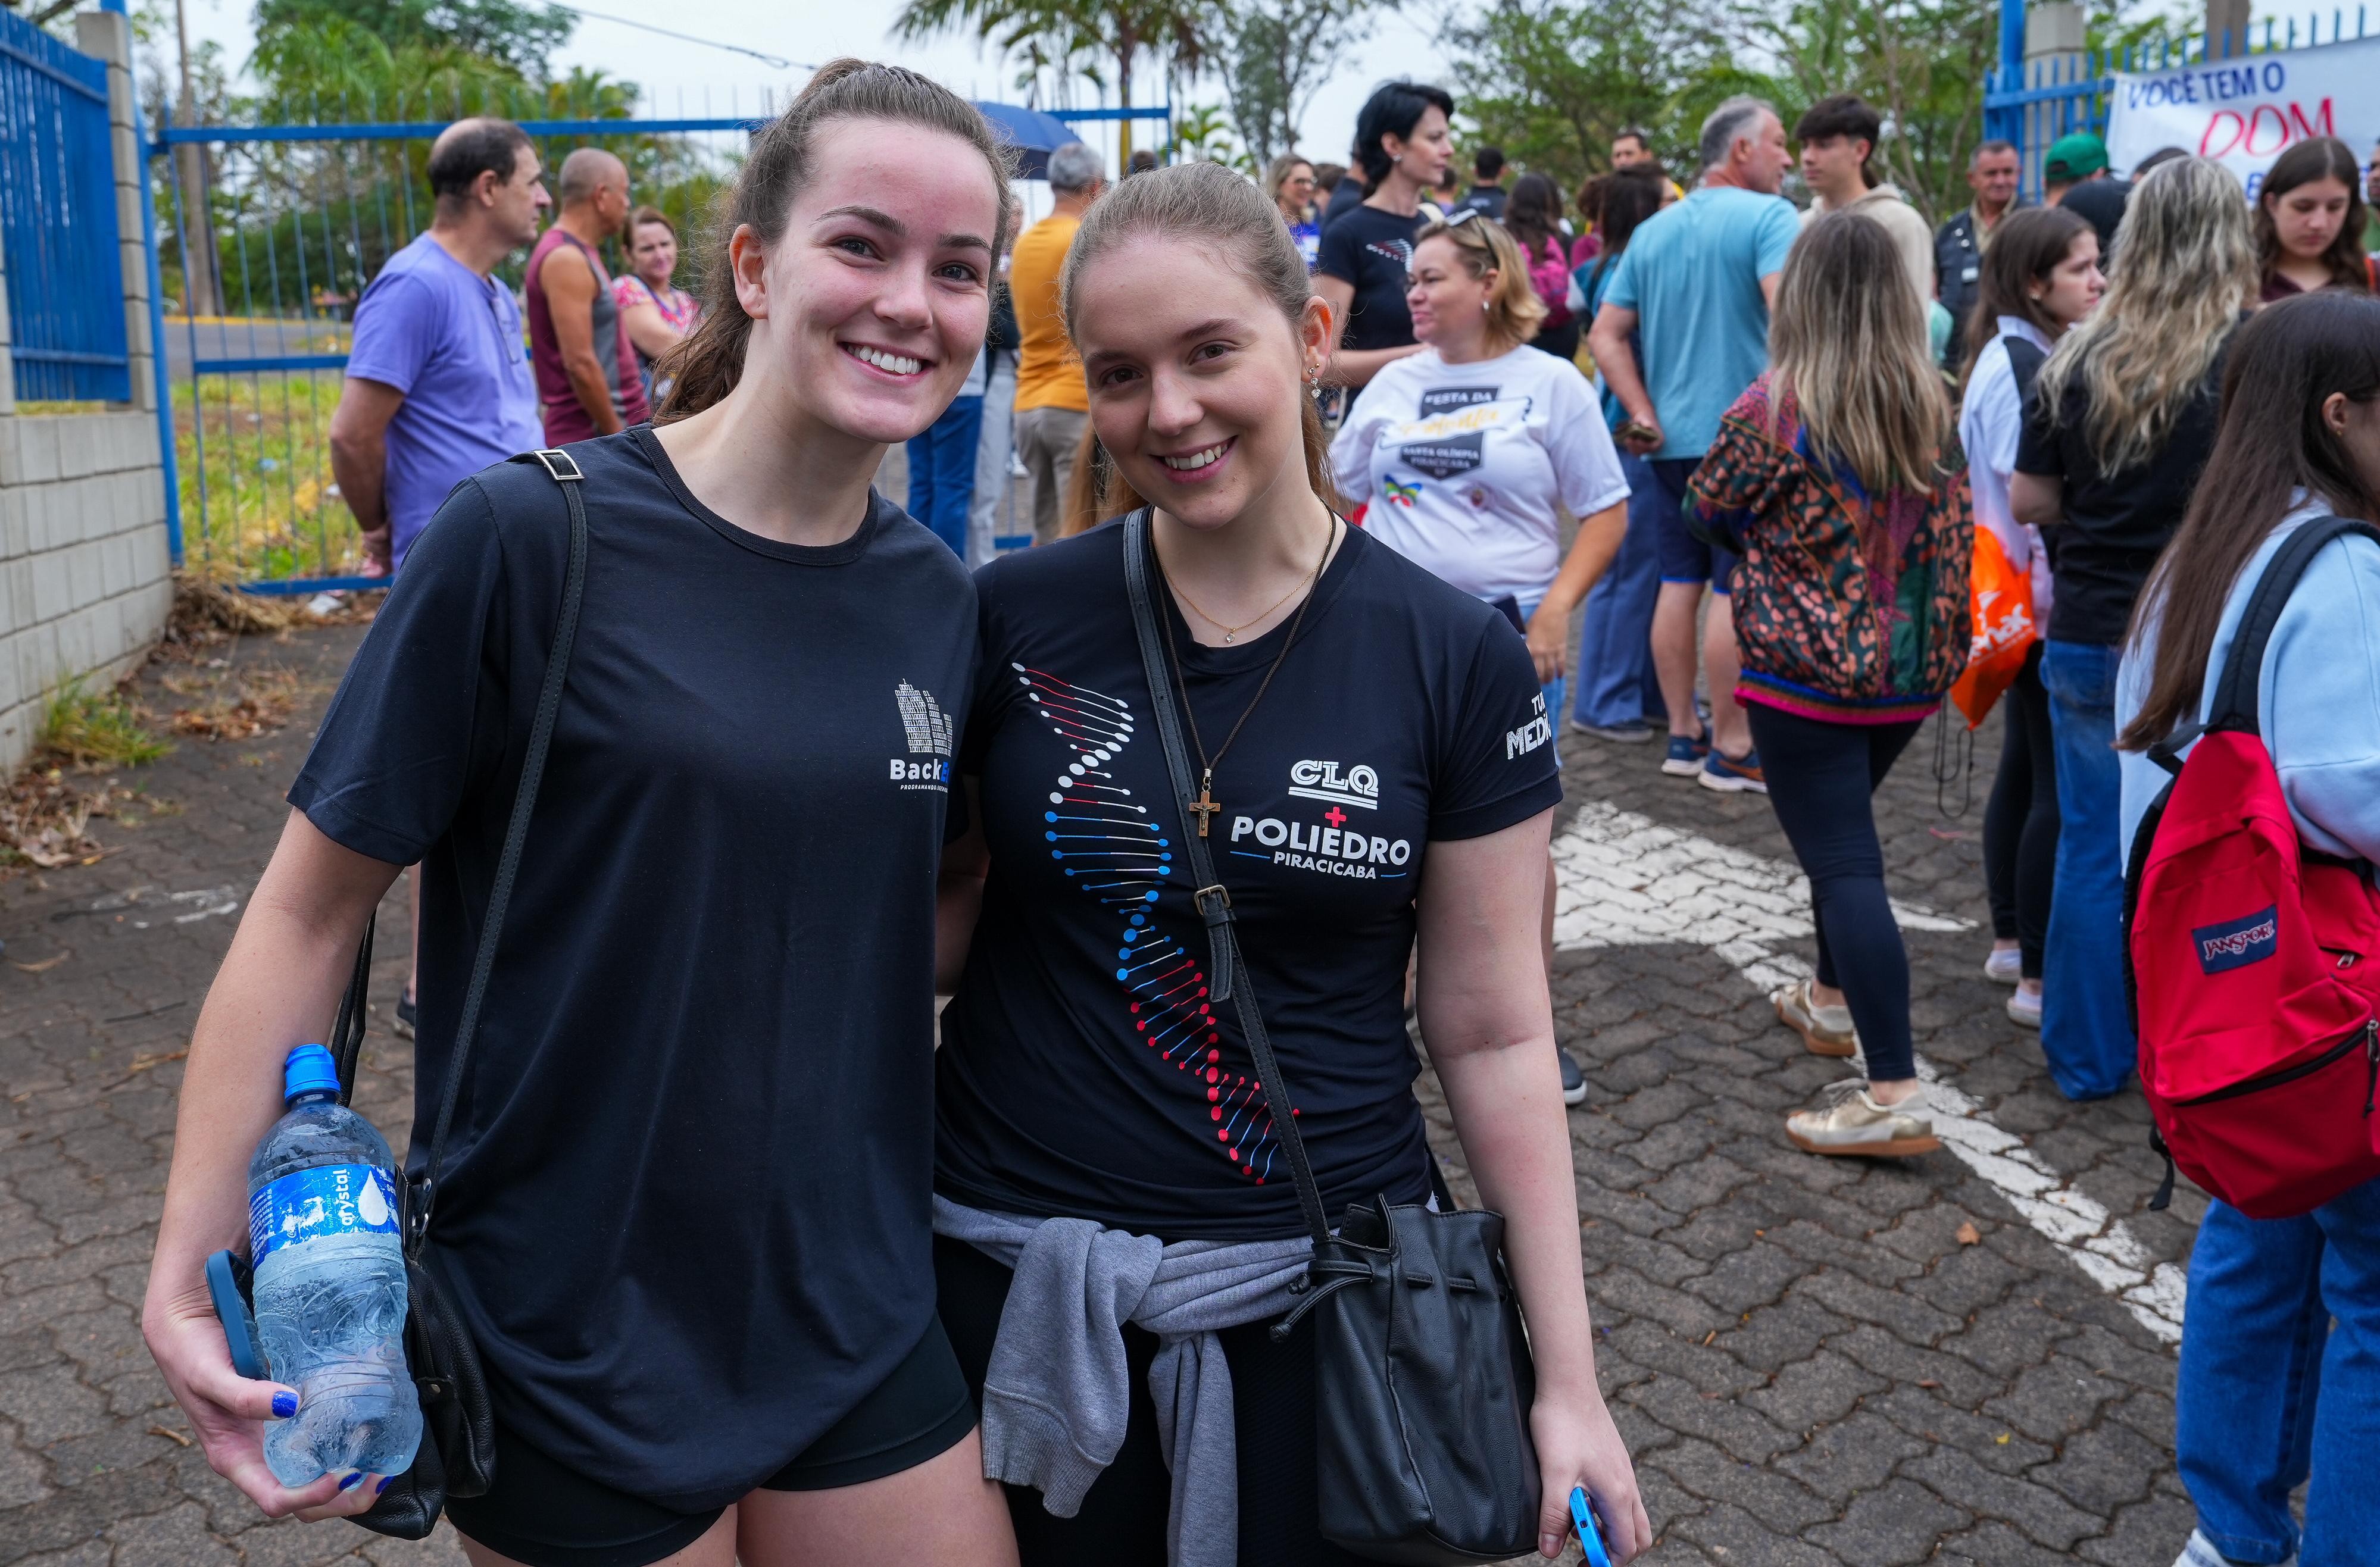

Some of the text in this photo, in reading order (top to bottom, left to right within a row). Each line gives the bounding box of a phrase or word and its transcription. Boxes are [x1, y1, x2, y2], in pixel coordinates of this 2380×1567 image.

[2129, 61, 2285, 109] VOCÊ TEM O
[2198, 96, 2335, 159] DOM
[1424, 391, 1492, 405] FESTA DA
[890, 758, 949, 783] BackE
[1291, 759, 1379, 797] CLQ
[1230, 816, 1410, 865] POLIEDRO
[1273, 851, 1376, 880] PIRACICABA
[2203, 919, 2275, 961] JANSPORT
